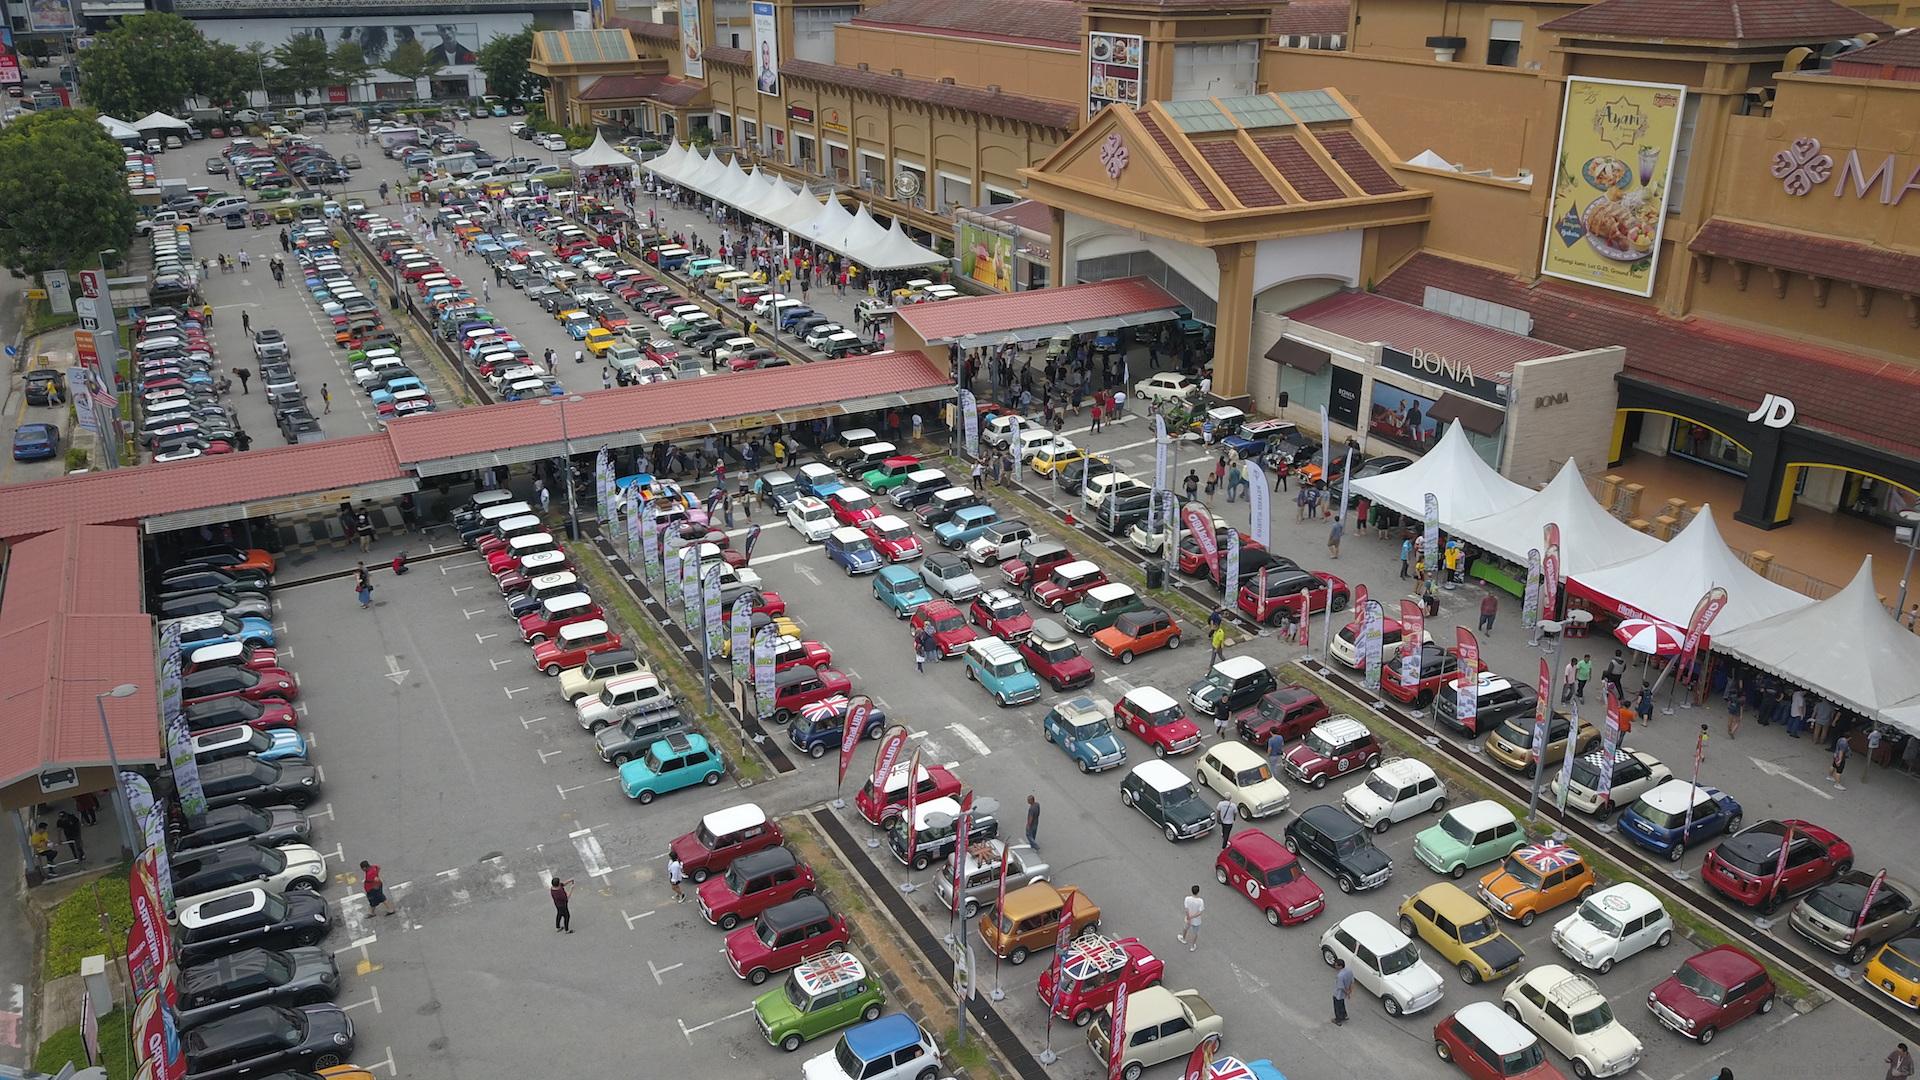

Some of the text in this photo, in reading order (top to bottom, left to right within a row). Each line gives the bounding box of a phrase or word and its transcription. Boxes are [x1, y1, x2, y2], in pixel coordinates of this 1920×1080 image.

[1410, 347, 1476, 387] BONIA
[1535, 391, 1570, 409] BONIA
[1746, 393, 1796, 429] JD
[1250, 881, 1257, 893] 7
